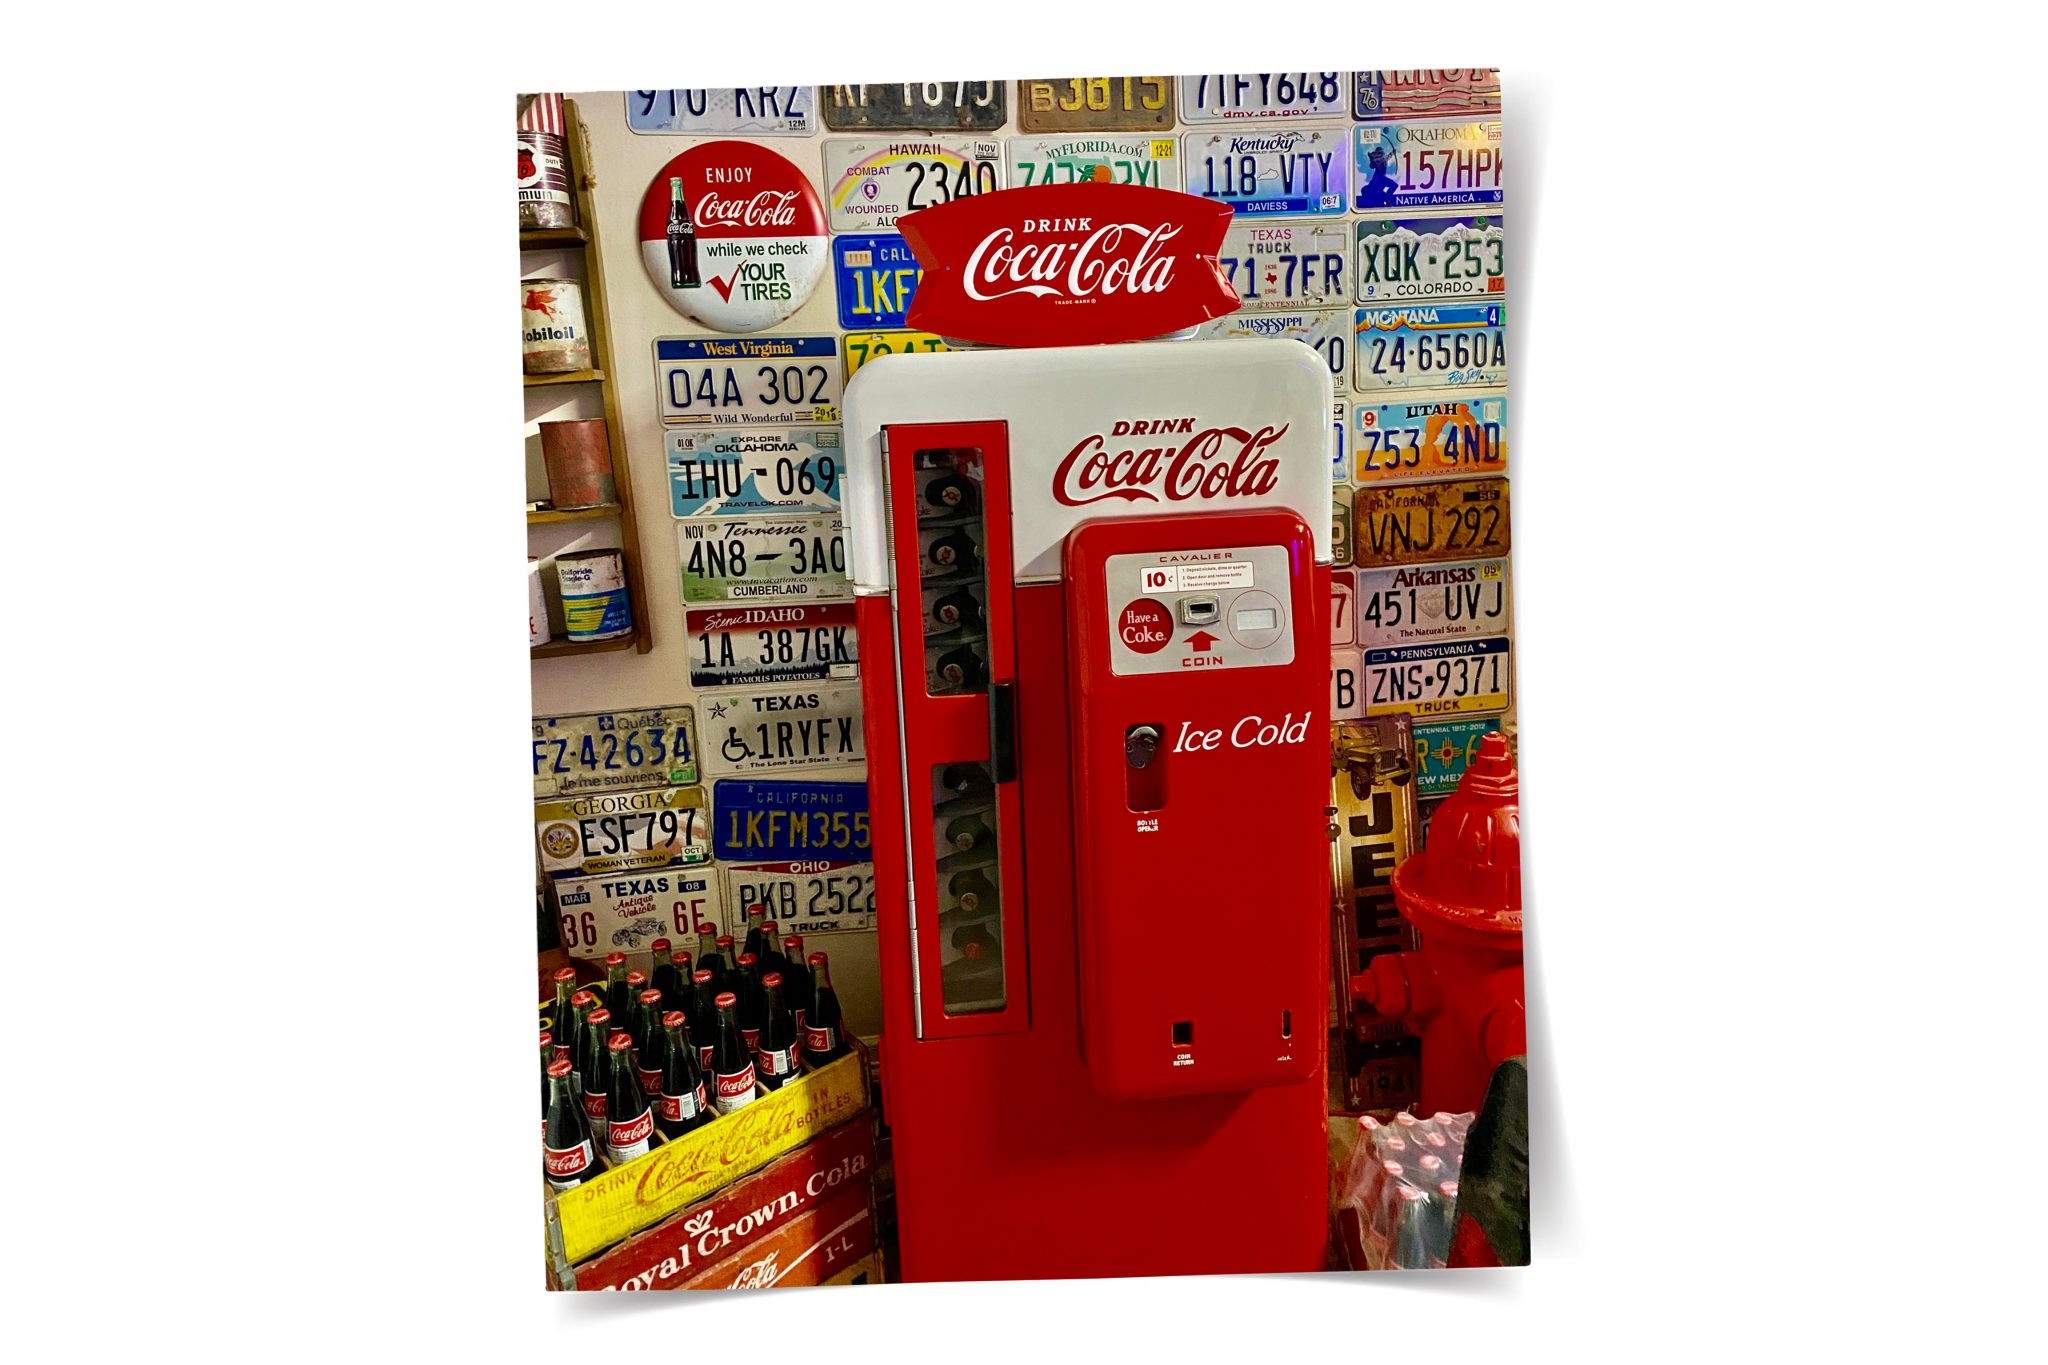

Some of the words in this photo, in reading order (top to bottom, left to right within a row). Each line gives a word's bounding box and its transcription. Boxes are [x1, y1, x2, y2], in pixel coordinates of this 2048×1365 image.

[1223, 108, 1309, 118] dmv.ca.gov
[1396, 127, 1478, 146] OKLAHOMA
[889, 143, 941, 155] HAWAII
[978, 144, 996, 152] NOV
[1045, 140, 1143, 160] MYFLORIDA.COM
[1155, 144, 1173, 157] 12-21
[1229, 136, 1297, 154] Kentucky
[706, 167, 753, 184] ENJOY
[846, 166, 891, 177] COMBAT
[1202, 156, 1257, 197] 118
[1280, 152, 1333, 195] VTY
[1247, 201, 1288, 212] DAVIESS
[1431, 193, 1475, 204] AMERICA
[694, 190, 801, 228] Coca-Cola
[845, 204, 899, 214] WOUNDED
[1023, 218, 1092, 233] DRINK
[1250, 229, 1292, 241] TEXAS
[706, 242, 742, 257] while
[745, 246, 765, 256] we
[767, 241, 808, 255] check
[1248, 242, 1292, 254] TRUCK
[963, 222, 1184, 302] Coca-Cola
[738, 263, 785, 282] YOUR
[1279, 254, 1343, 297] 7FR
[740, 282, 792, 301] TIRES
[852, 269, 924, 315] 1KF
[1367, 285, 1375, 296] 9
[1396, 281, 1473, 296] COLORADO
[1366, 308, 1439, 325] MONTANA
[1489, 308, 1497, 323] 4
[1238, 317, 1302, 335] MISSISSIPPI
[703, 342, 737, 356] West
[740, 341, 794, 356] Virginia
[757, 365, 830, 405] 302
[713, 413, 738, 424] Wild
[742, 412, 794, 423] Wonderful
[1364, 411, 1376, 426] 9
[1405, 403, 1458, 419] UTAH
[1111, 417, 1197, 436] DRINK
[731, 435, 782, 443] EXPLORE
[714, 443, 799, 453] OKLAHOMA
[1364, 428, 1420, 471] Z53
[1052, 422, 1290, 507] Coca-Cola
[718, 500, 804, 508] TRAVELOK.COM
[1479, 491, 1496, 501] 56
[685, 525, 704, 539] NOV
[723, 522, 808, 540] Tennessee
[1368, 509, 1434, 555] VNJ
[1446, 505, 1500, 551] 292
[1160, 552, 1233, 563] CAVALIER
[726, 576, 818, 586] www.tnvacation.com
[1147, 571, 1166, 588] 10
[1392, 567, 1476, 589] Arkansas
[733, 584, 808, 597] CUMBERLAND
[1364, 589, 1416, 628] 451
[1445, 582, 1502, 621] UVJ
[705, 614, 747, 631] Scenic
[745, 608, 805, 623] IDAHO
[1127, 610, 1151, 624] Have
[1152, 613, 1159, 622] a
[1400, 629, 1414, 638] The
[1415, 627, 1444, 637] Natural
[1446, 625, 1467, 634] State
[699, 632, 735, 669] 1A
[758, 626, 849, 665] 387GK
[1400, 644, 1474, 660] PENNSYLVANIA
[1182, 656, 1223, 667] COIN
[732, 674, 770, 685] FAMOUS
[772, 672, 820, 682] POTATOES
[752, 693, 820, 713] TEXAS
[1415, 700, 1461, 713] TRUCK
[617, 714, 672, 730] Québec
[757, 717, 854, 760] 1RYFX
[1172, 721, 1223, 754] Ice
[1230, 711, 1312, 749] Cold
[767, 759, 787, 767] Lone
[808, 756, 830, 764] State
[579, 777, 601, 787] me
[604, 771, 664, 786] souviens
[573, 793, 668, 816] GEORGIA
[757, 792, 844, 804] CALIFORNIA
[579, 807, 697, 858] ESF797
[725, 810, 870, 848] 1KFM355
[684, 847, 700, 855] OCT
[587, 859, 623, 870] WOMAN
[624, 855, 666, 867] VETERAN
[789, 860, 830, 874] OHIO
[601, 877, 669, 898] TEXAS
[685, 882, 700, 891] 08
[563, 893, 588, 904] MAR
[612, 895, 654, 911] Antique
[617, 904, 656, 918] Vehicle
[789, 920, 840, 933] TRUCK
[796, 1092, 852, 1130] BOTTLES
[805, 1152, 868, 1197] Cola
[583, 1169, 637, 1202] DRINK
